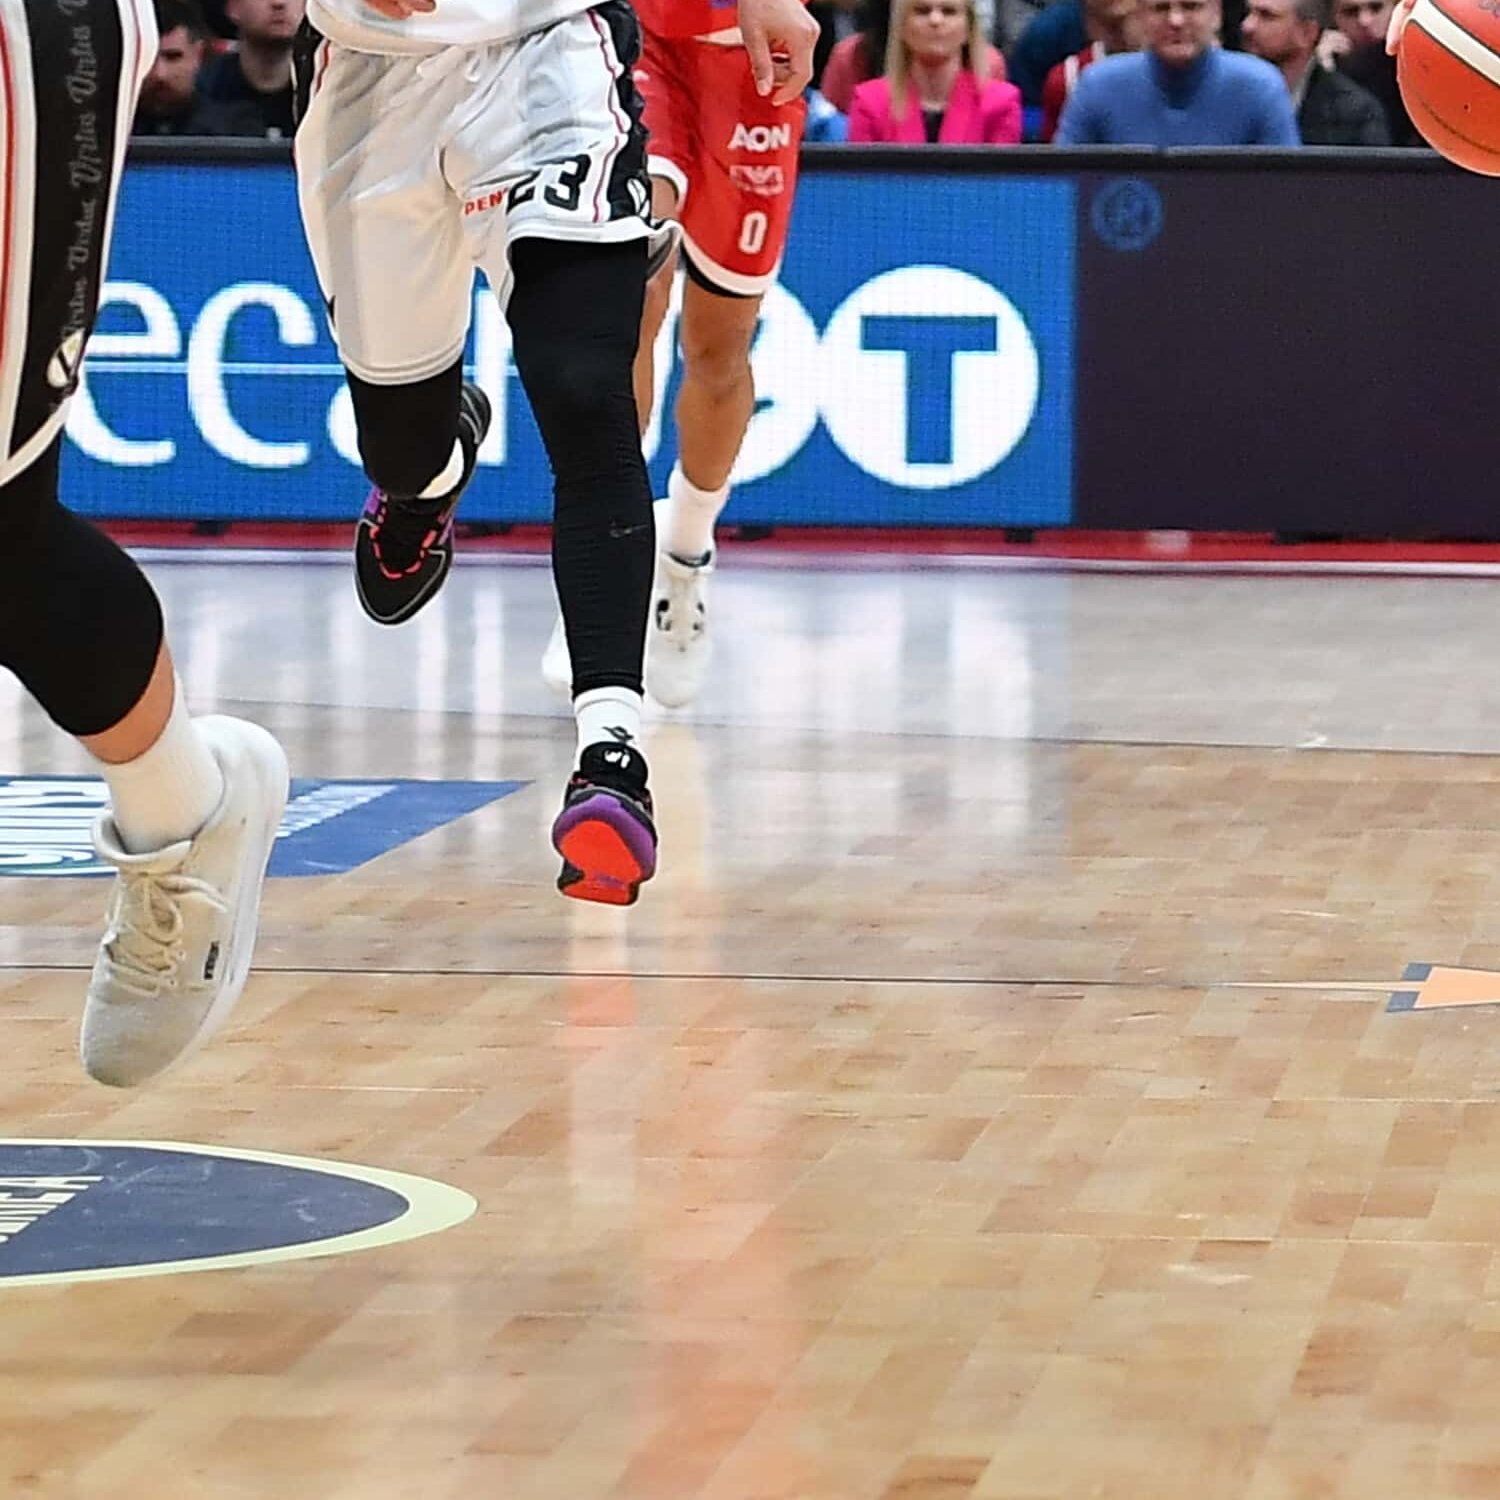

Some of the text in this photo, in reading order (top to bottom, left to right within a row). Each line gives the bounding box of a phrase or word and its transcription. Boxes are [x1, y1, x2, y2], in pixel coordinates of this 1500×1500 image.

[727, 122, 791, 152] AON
[506, 153, 591, 214] 23
[737, 210, 769, 255] 0
